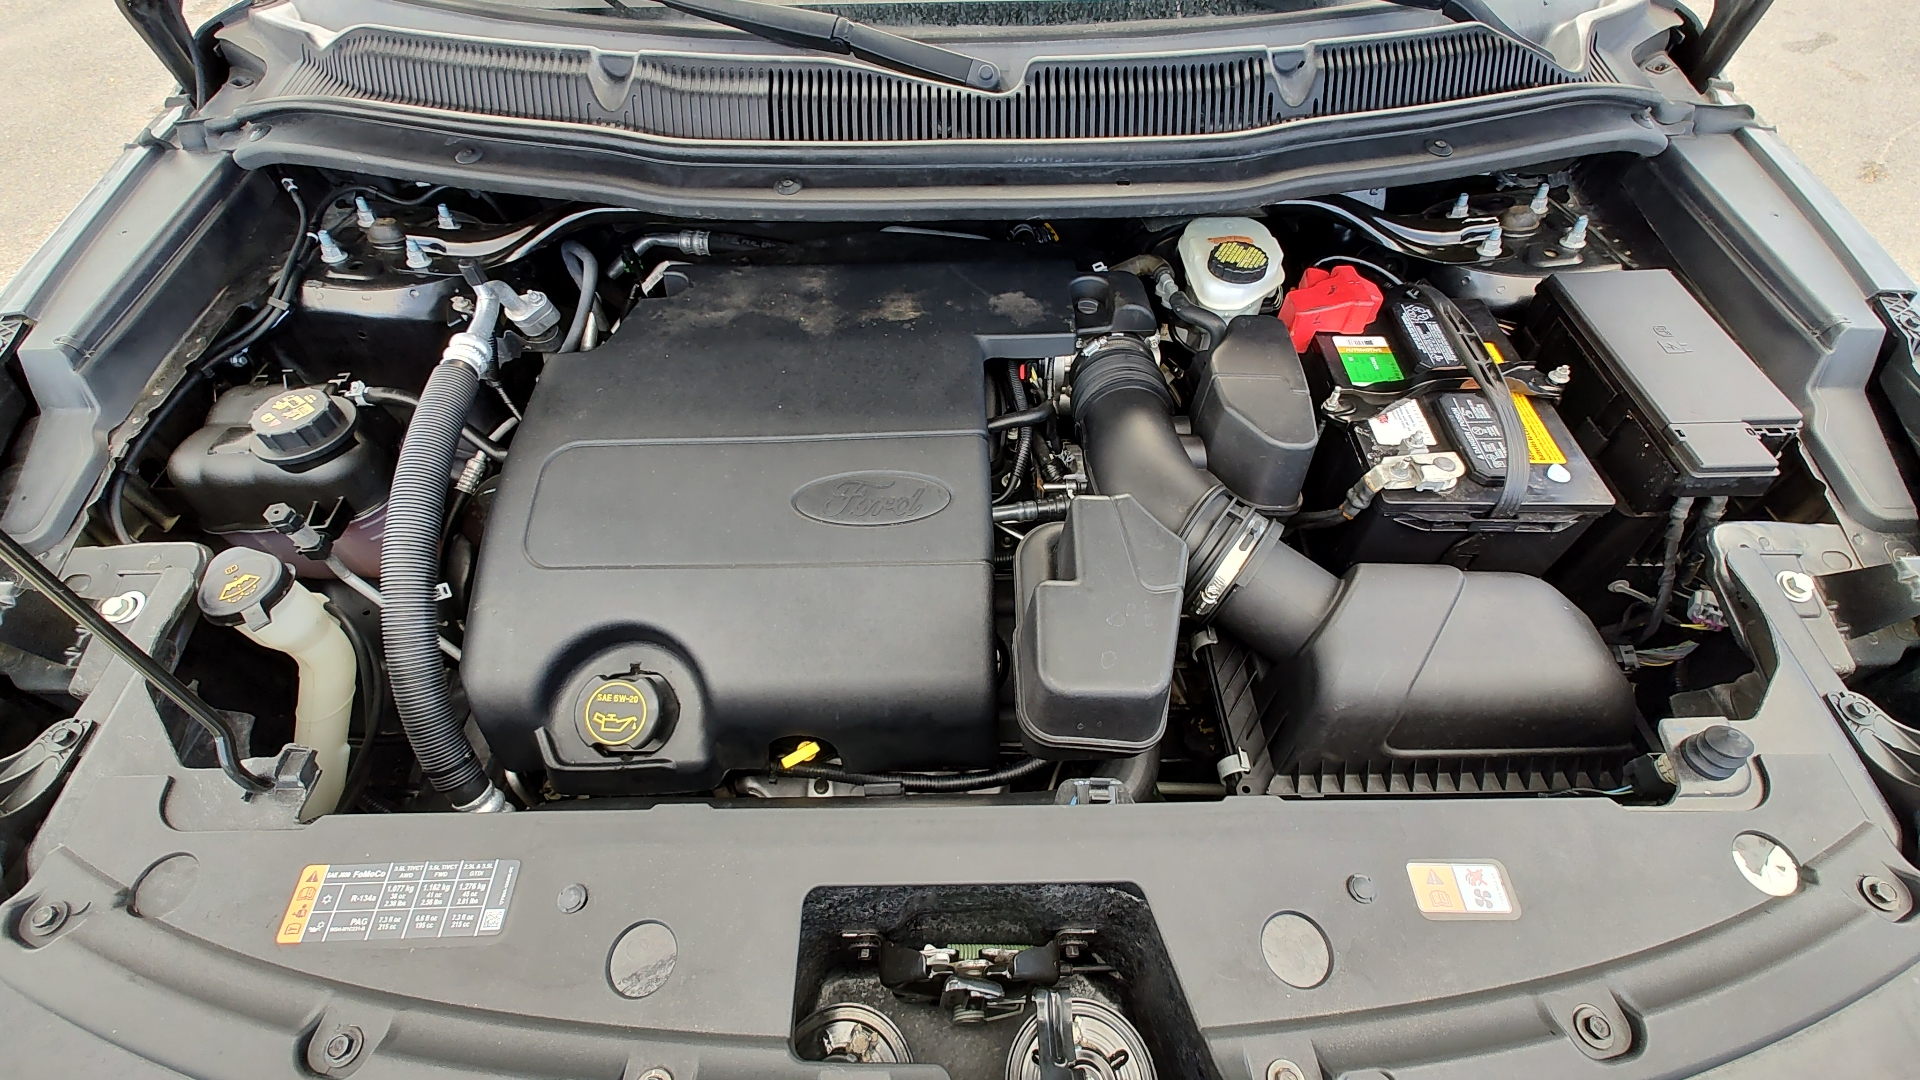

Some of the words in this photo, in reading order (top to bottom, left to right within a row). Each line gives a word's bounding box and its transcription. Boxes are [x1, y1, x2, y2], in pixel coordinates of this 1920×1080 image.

[823, 480, 926, 518] Ford
[597, 693, 612, 702] SAE
[613, 694, 639, 704] 5W-20
[352, 870, 386, 879] FoMoCo
[405, 884, 415, 893] kg
[441, 883, 451, 892] kg
[477, 882, 487, 892] kg
[350, 894, 377, 903] R-134a
[350, 917, 368, 926] PAG
